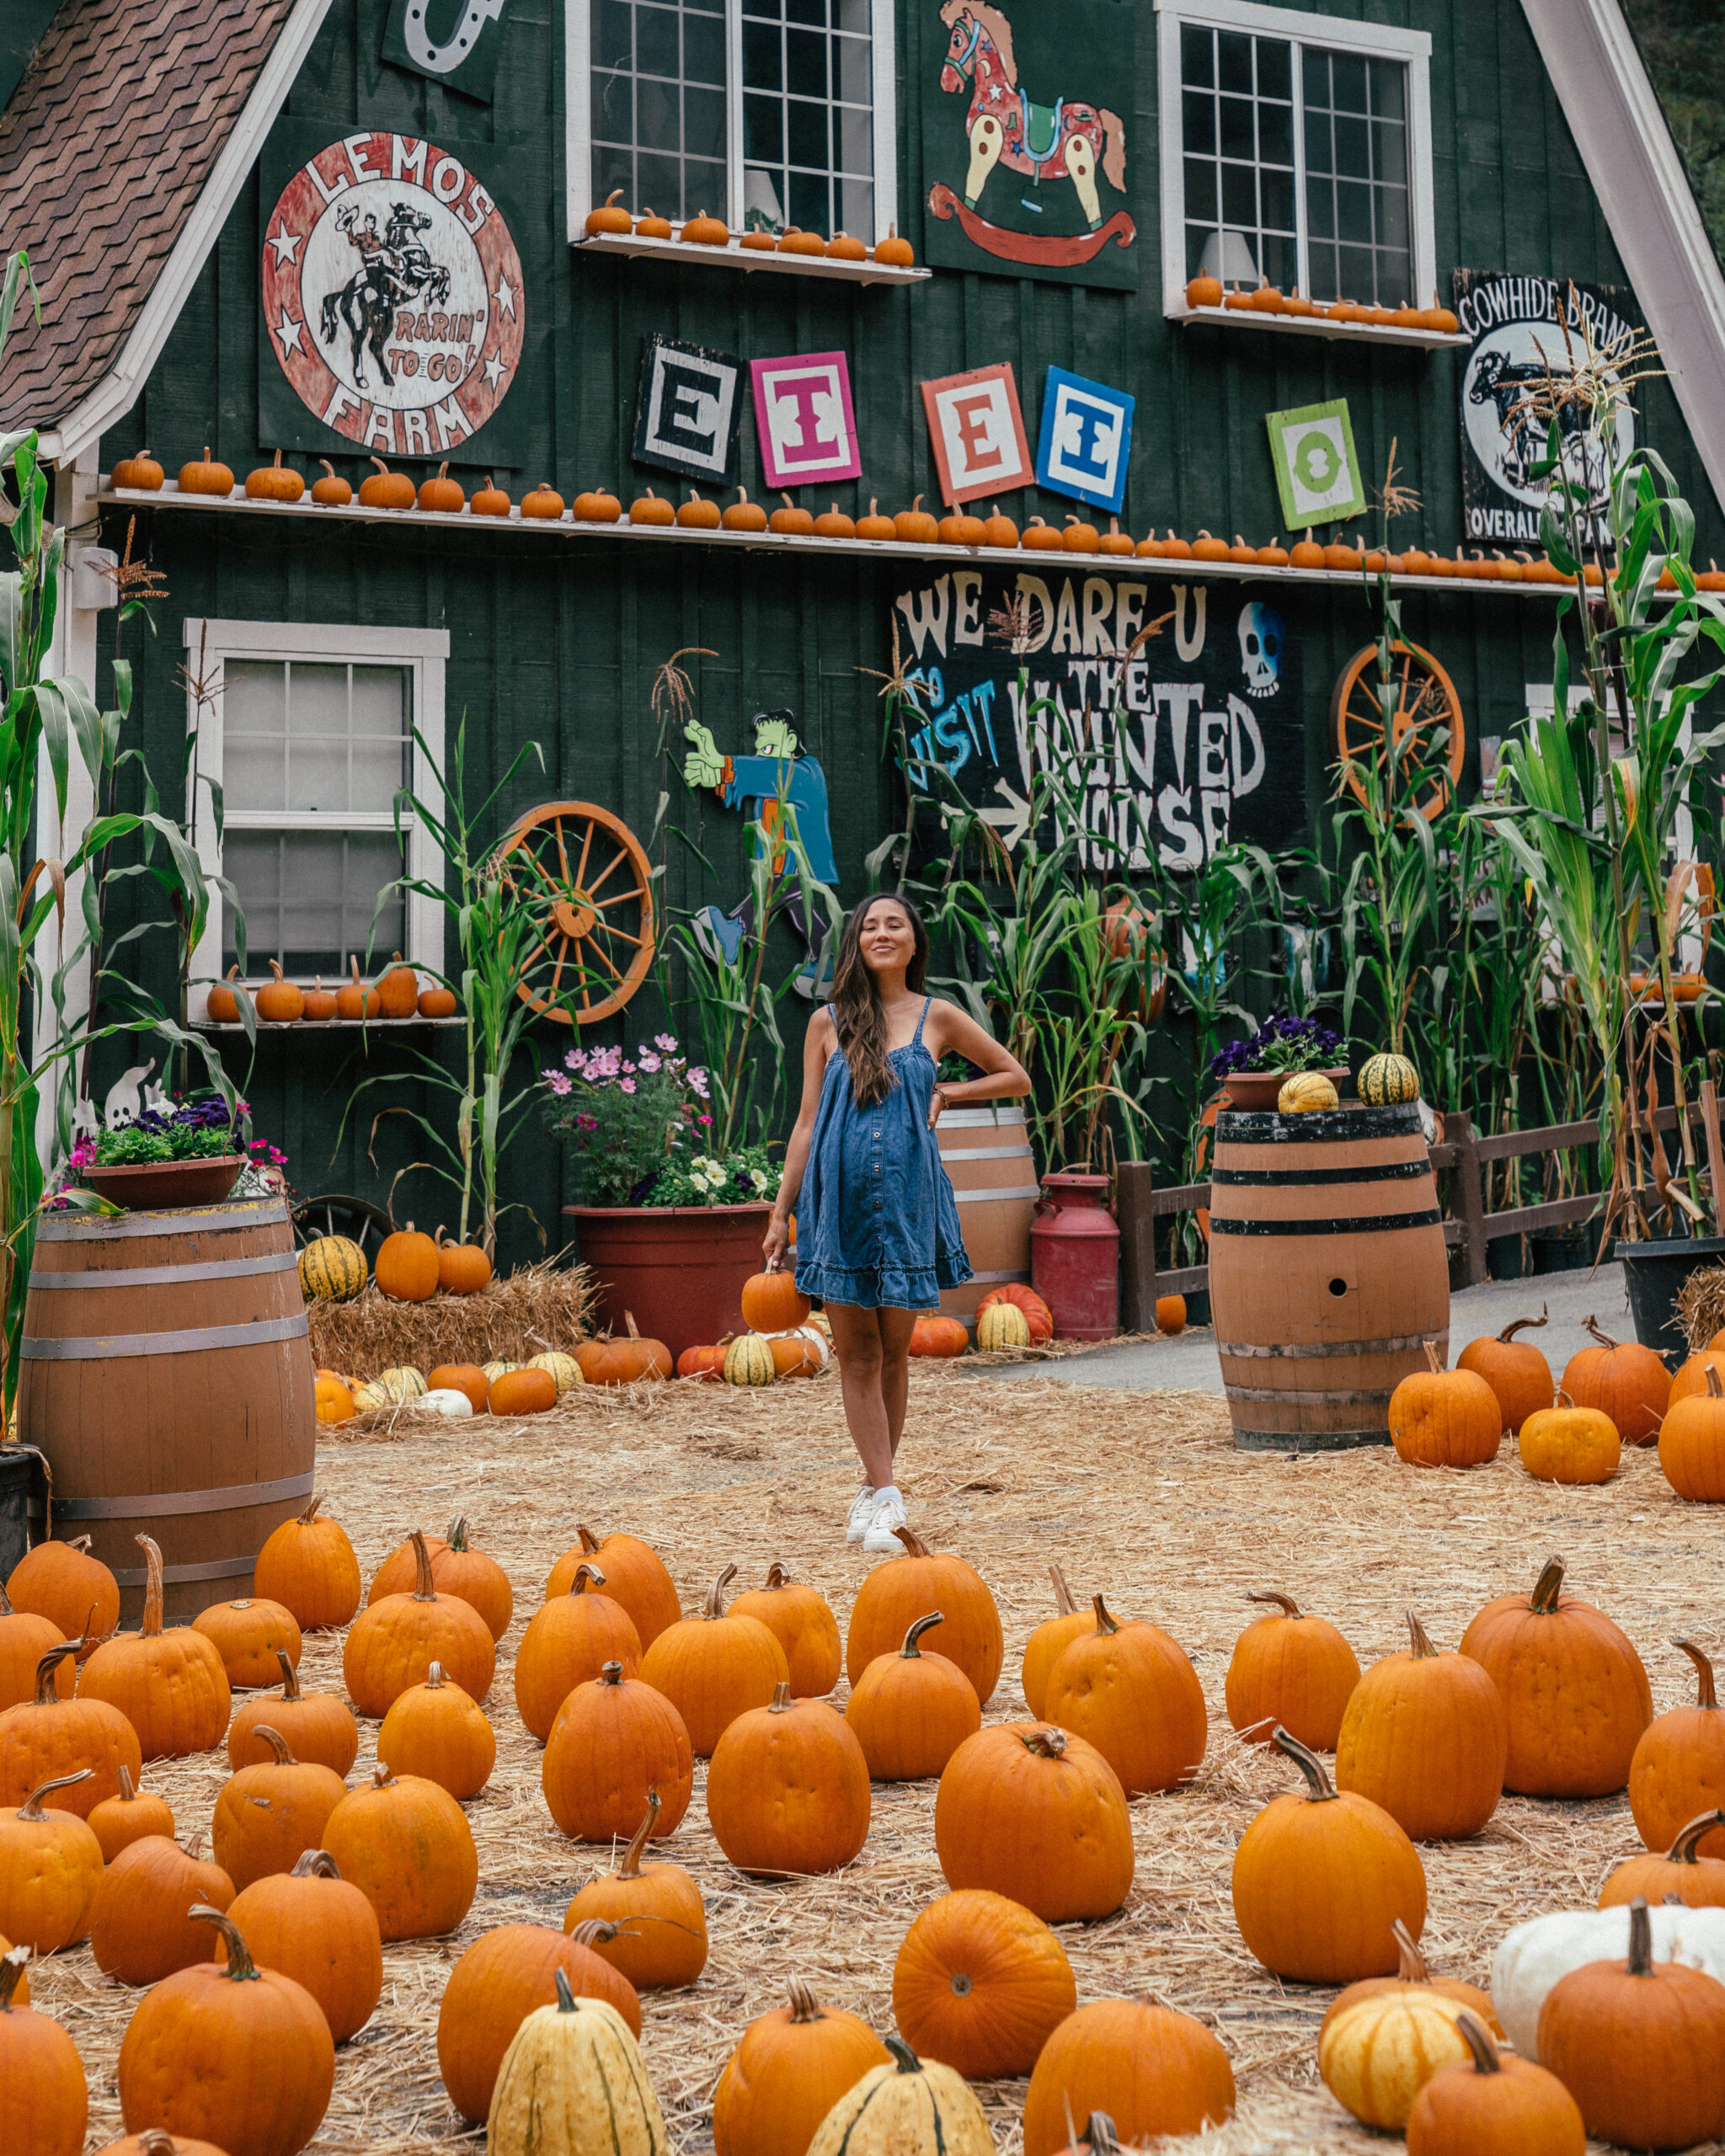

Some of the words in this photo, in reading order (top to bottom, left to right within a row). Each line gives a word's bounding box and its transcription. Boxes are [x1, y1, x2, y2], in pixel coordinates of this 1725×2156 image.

[305, 132, 496, 235] LEMOS
[1459, 277, 1559, 336] COWHIDE
[1567, 285, 1635, 361] BRAND
[388, 349, 419, 376] TO
[323, 383, 475, 455] FARM
[654, 360, 722, 454] E
[774, 376, 839, 463] I
[953, 398, 1001, 473] E
[1060, 399, 1114, 479] I
[1293, 430, 1343, 494] O
[896, 571, 984, 659] WE
[1011, 573, 1148, 660] DARE
[1171, 584, 1207, 662] U
[901, 666, 945, 725] TO
[1067, 660, 1151, 712] THE
[1007, 680, 1266, 798] HAUNTED
